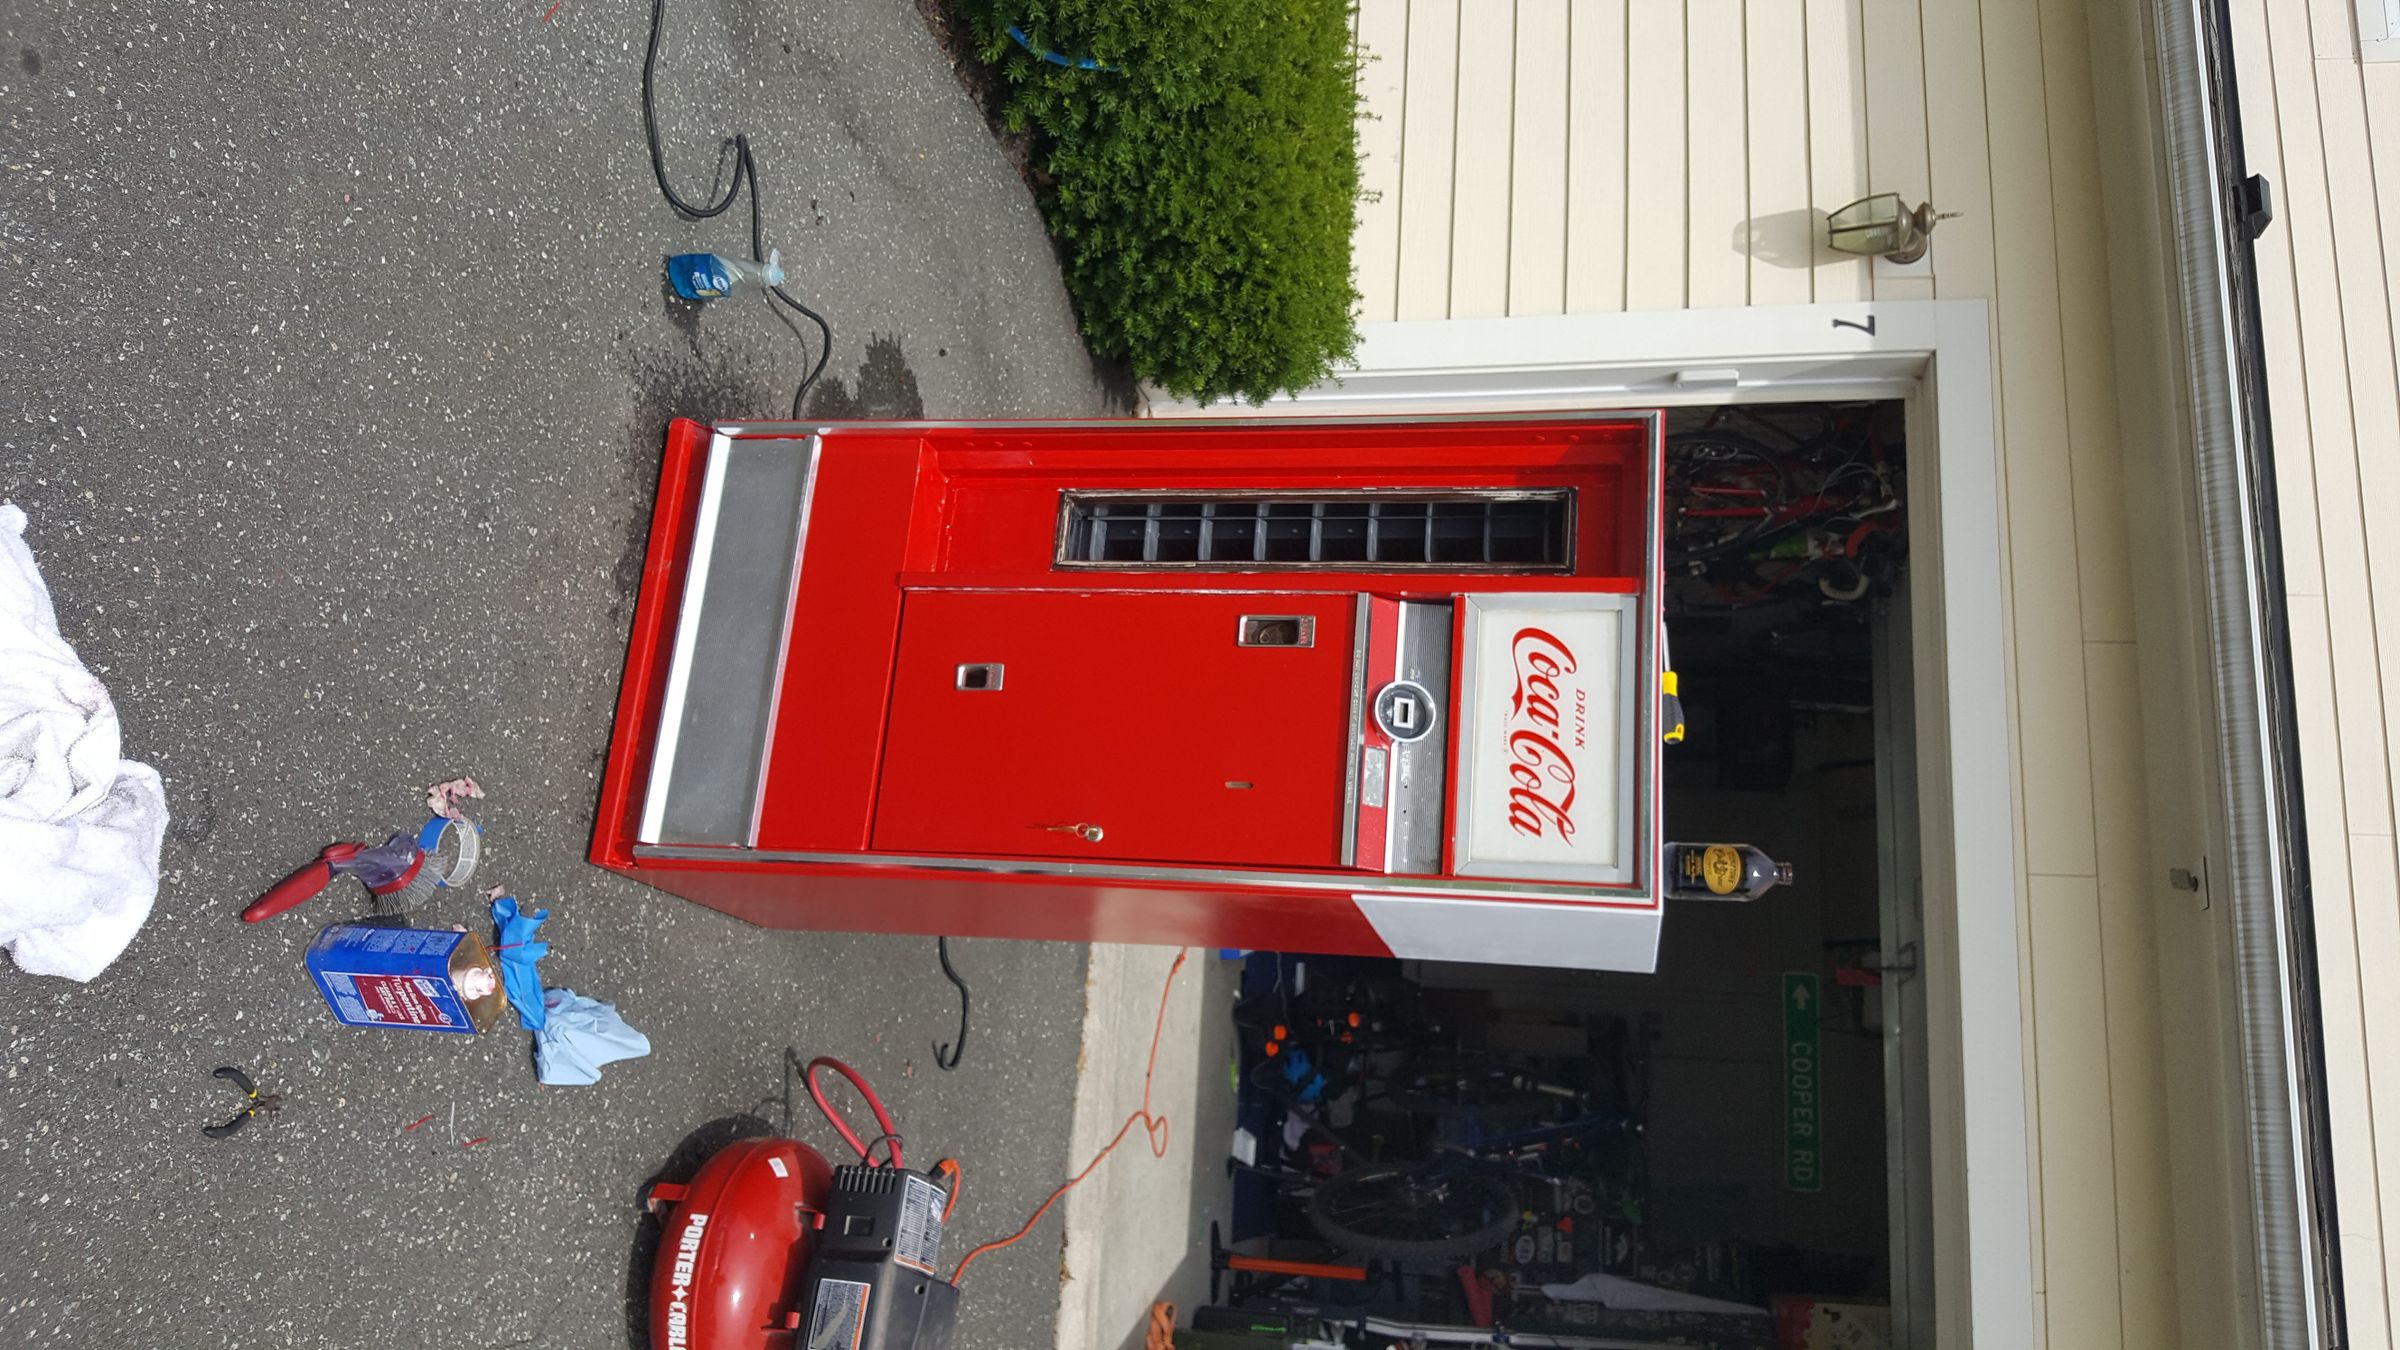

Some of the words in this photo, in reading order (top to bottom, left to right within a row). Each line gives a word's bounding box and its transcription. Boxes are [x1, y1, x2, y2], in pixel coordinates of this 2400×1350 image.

[1832, 314, 1875, 337] 7
[1508, 627, 1578, 848] Coca-Cola
[1574, 688, 1586, 751] DRINK
[391, 977, 422, 1024] Turpentine
[1791, 1041, 1813, 1137] COOPER
[1792, 1149, 1814, 1182] RD
[671, 1213, 709, 1287] PORTER
[667, 1301, 688, 1350] CABL
